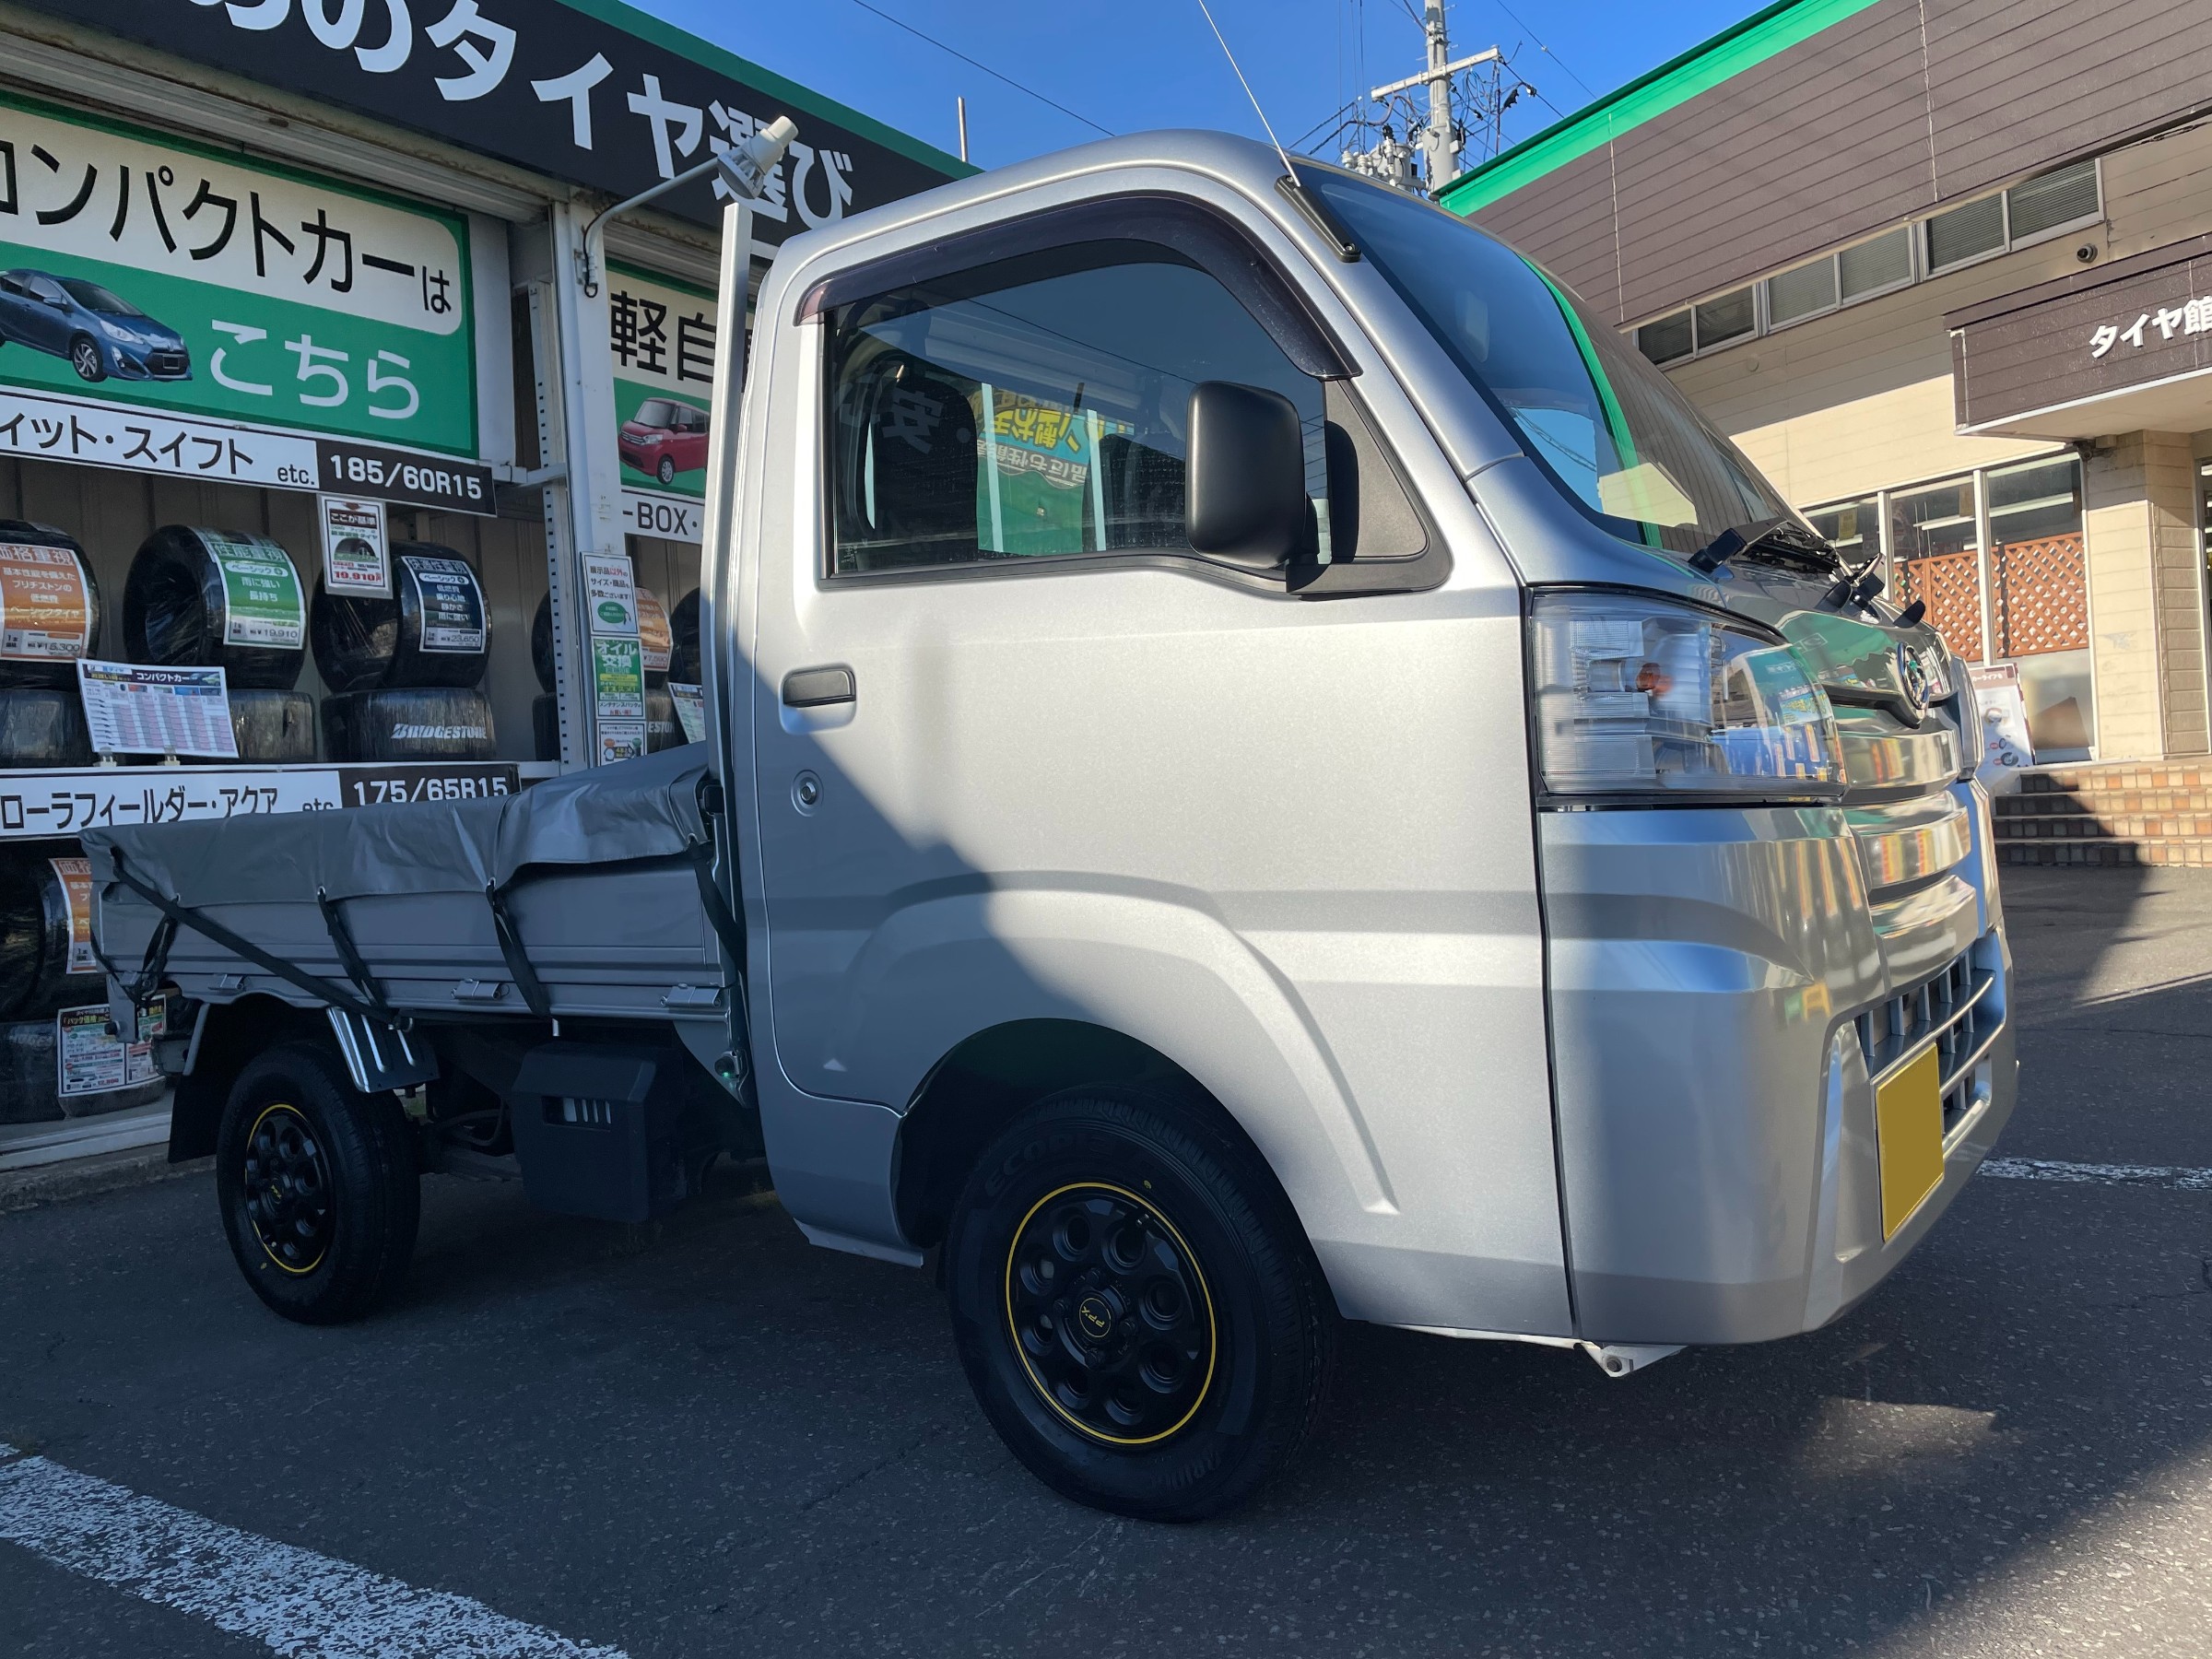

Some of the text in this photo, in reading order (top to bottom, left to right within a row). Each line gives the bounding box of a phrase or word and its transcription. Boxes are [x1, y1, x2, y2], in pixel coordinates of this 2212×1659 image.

[189, 0, 853, 230] のタイヤ選び
[2088, 295, 2212, 359] タイヤ館
[210, 319, 420, 420] こちら
[277, 464, 315, 486] etc.
[330, 453, 482, 500] 185/60R15
[596, 641, 638, 655] オイル
[601, 653, 632, 668] 交換
[136, 672, 190, 683] コンパクトカー
[390, 723, 488, 739] BRIDGESTONE
[353, 777, 508, 806] 175/65R15
